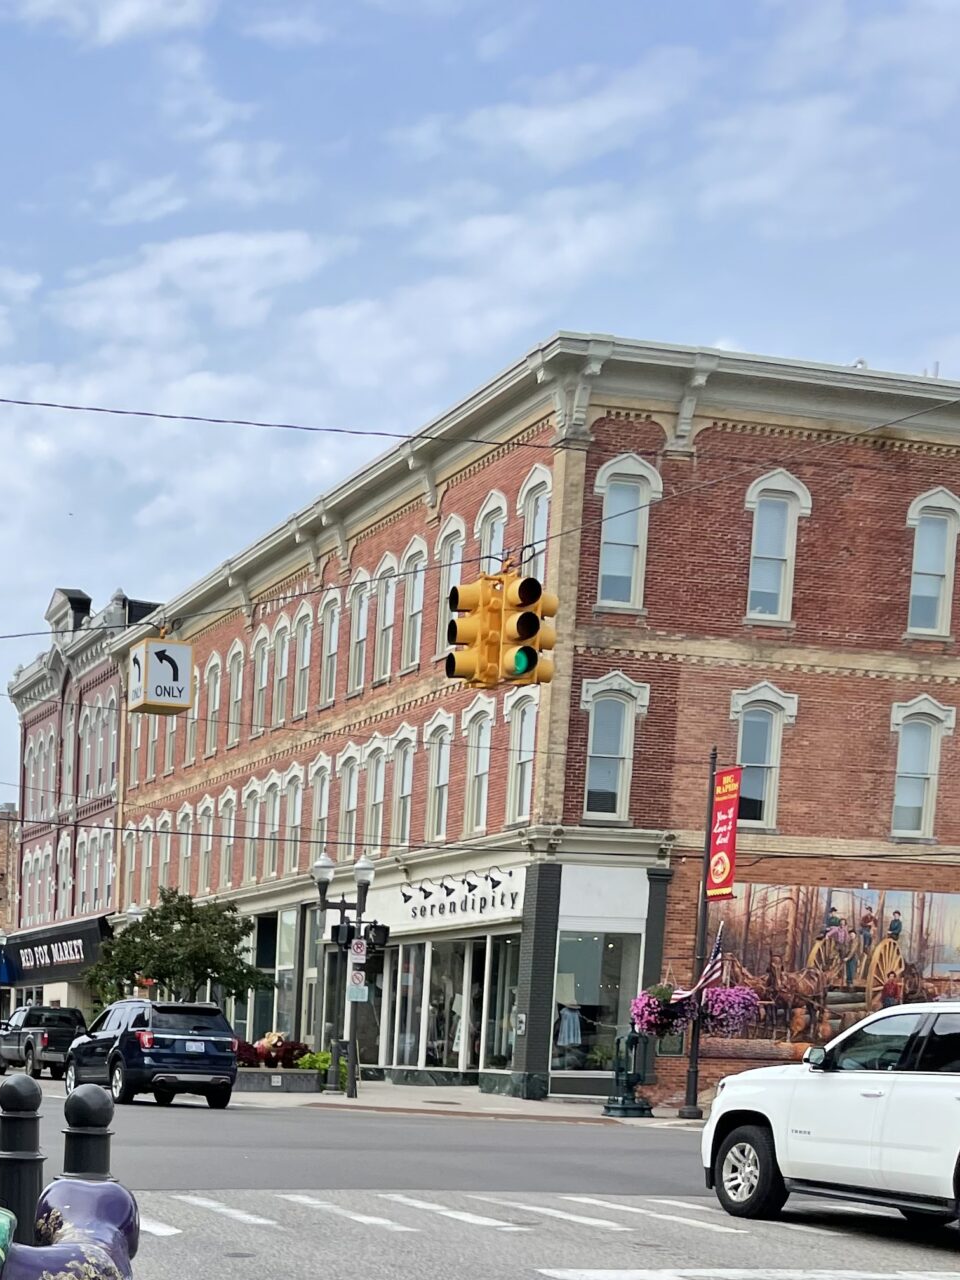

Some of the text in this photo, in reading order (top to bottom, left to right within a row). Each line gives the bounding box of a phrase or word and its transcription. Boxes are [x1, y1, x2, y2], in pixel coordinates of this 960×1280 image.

[155, 685, 184, 698] ONLY
[411, 890, 519, 918] serendipity
[20, 939, 84, 967] RED FOX MARKET
